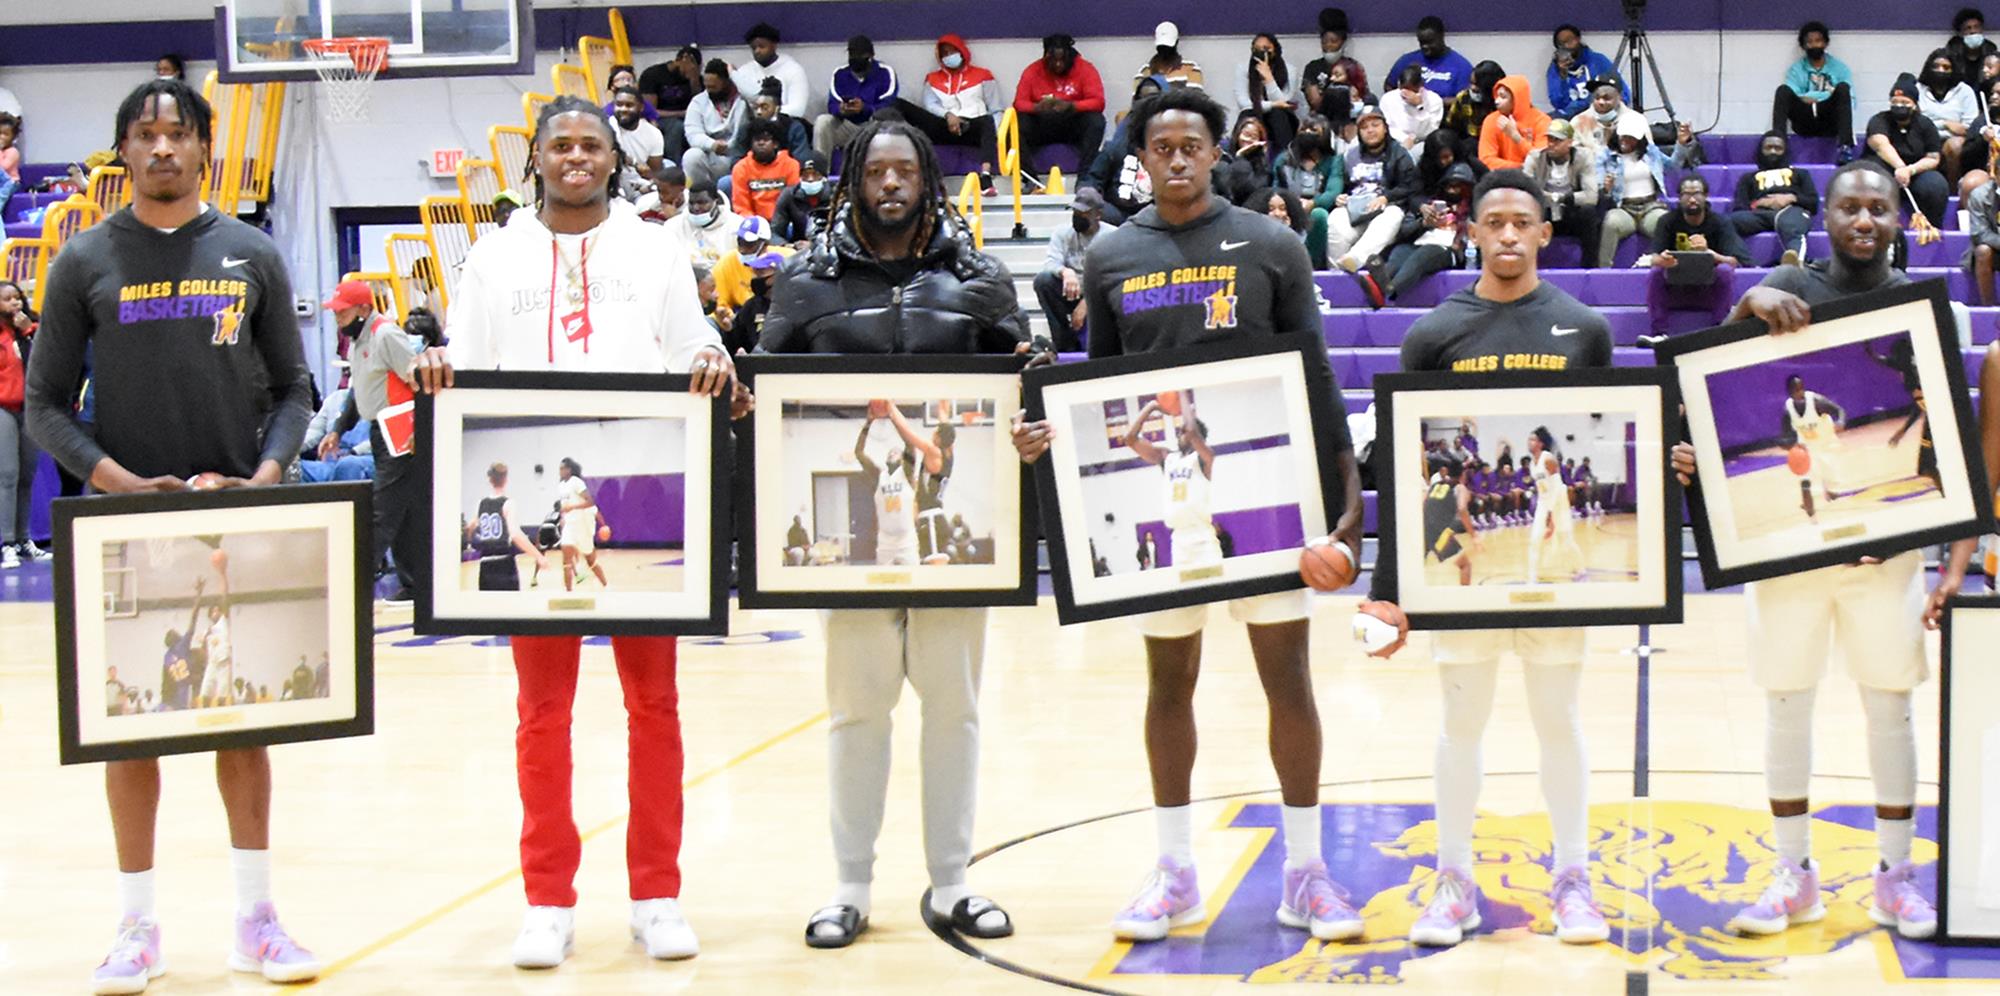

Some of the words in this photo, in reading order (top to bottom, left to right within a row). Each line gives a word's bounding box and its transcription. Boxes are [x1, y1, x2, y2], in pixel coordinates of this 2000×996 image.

[434, 150, 464, 173] EXIT
[120, 281, 172, 301] MILES
[179, 279, 247, 296] COLLEGE
[1122, 271, 1167, 294] MILES
[1171, 266, 1237, 284] COLLEGE
[118, 295, 237, 324] BASKETBA
[1121, 281, 1225, 316] BASKETBA
[1452, 355, 1499, 372] MILES
[1503, 353, 1568, 370] COLLEGE
[479, 512, 503, 540] 20
